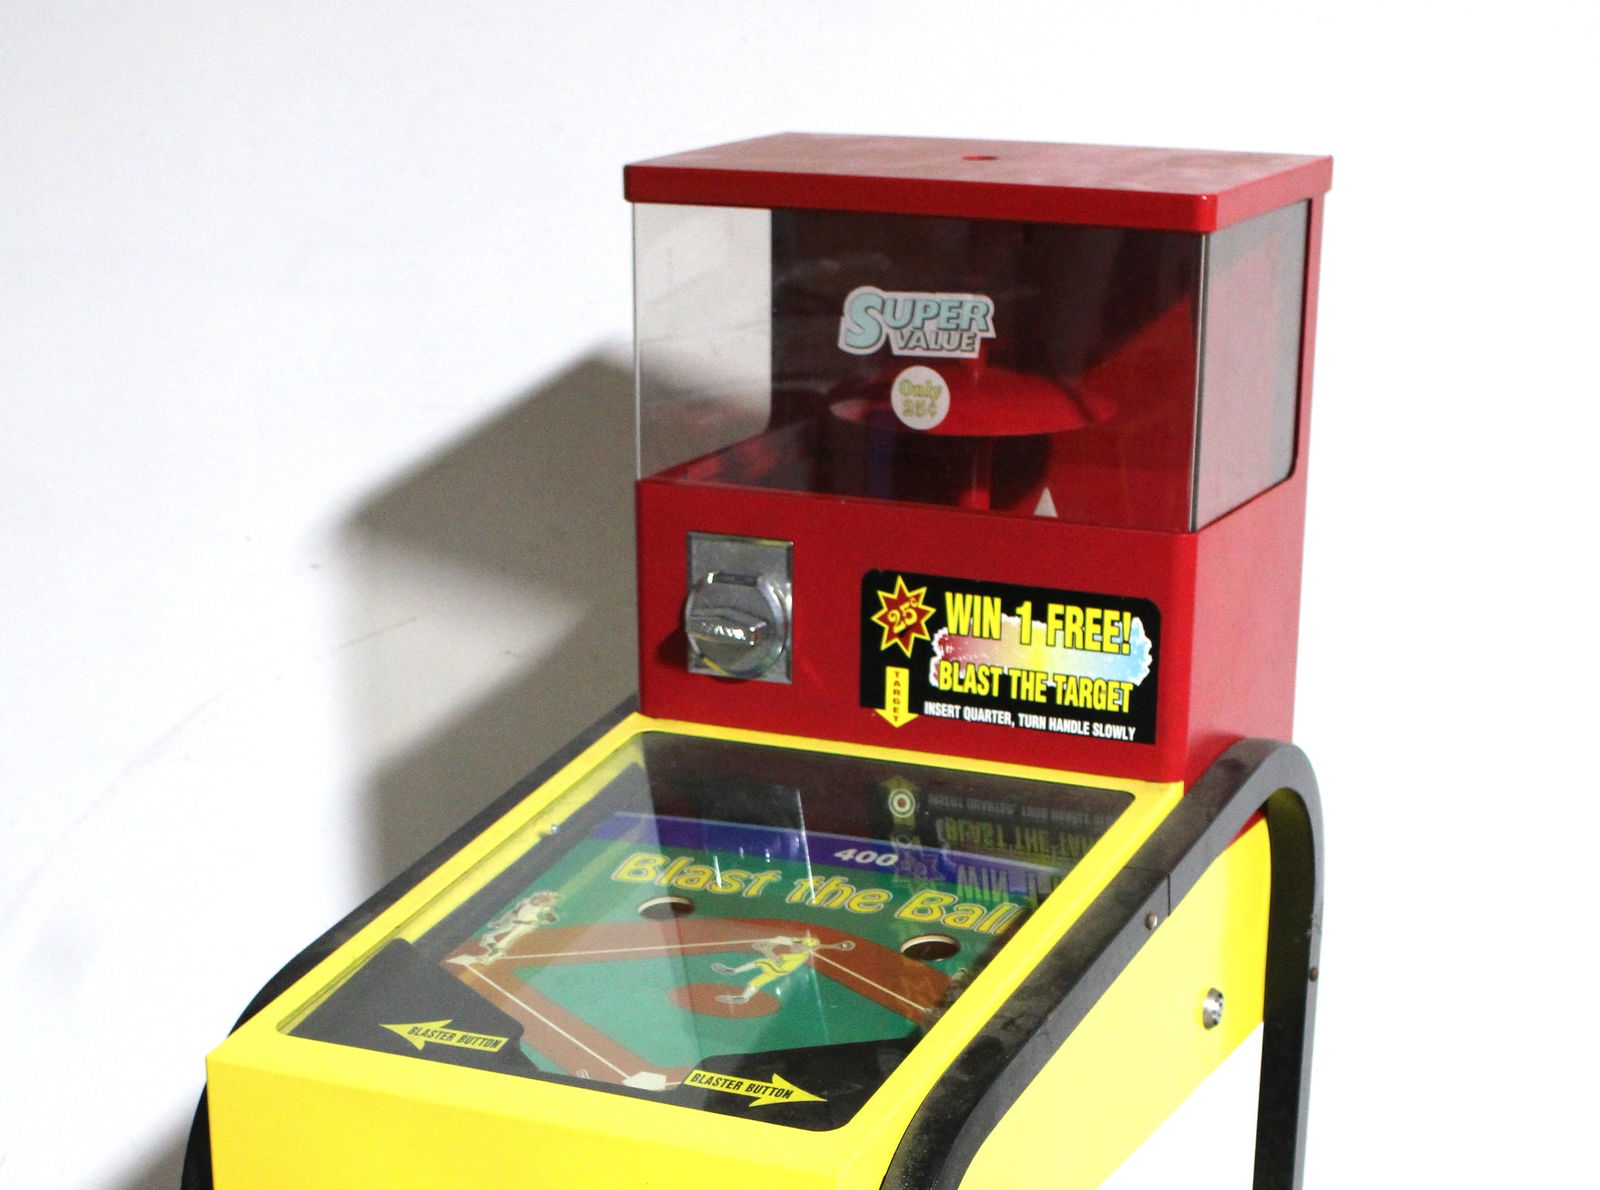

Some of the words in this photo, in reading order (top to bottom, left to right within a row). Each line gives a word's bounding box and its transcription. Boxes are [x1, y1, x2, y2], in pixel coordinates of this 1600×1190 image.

[845, 292, 990, 348] SUPER
[896, 330, 977, 352] VALUE
[945, 591, 1001, 641] WIN
[1016, 601, 1032, 646] 1
[1046, 602, 1132, 656] FREE!
[892, 670, 901, 722] TARGET
[938, 659, 1003, 698] BLAST
[1009, 668, 1047, 704] THE
[1054, 673, 1134, 714] TARGET
[923, 700, 962, 718] INSERT
[963, 705, 1015, 728] QUARTER,
[1018, 713, 1047, 731] TURN
[1048, 719, 1090, 736] HANDLE
[1092, 722, 1136, 742] SLOWLY
[833, 847, 898, 867] 400
[613, 851, 783, 899] Blast
[788, 872, 893, 914] the
[407, 1025, 455, 1042] BLASTER
[457, 1034, 501, 1050] BUTTON
[690, 1072, 742, 1093] BLASTER
[745, 1084, 795, 1100] BUTTON
